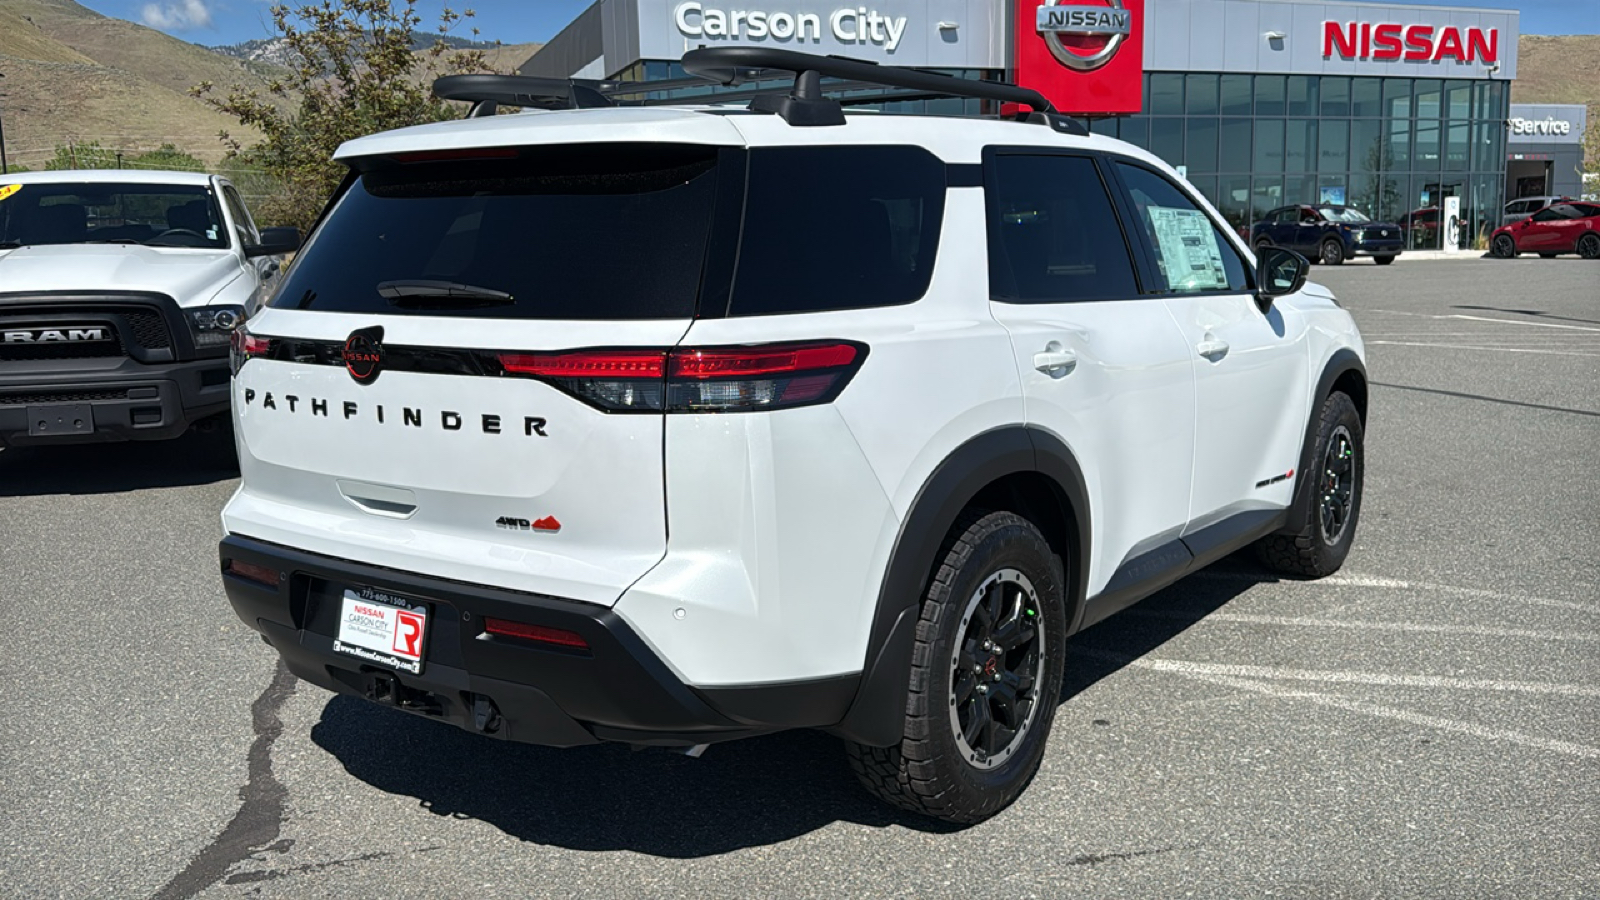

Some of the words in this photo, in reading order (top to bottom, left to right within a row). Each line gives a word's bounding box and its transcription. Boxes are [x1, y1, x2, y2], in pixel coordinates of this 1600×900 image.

[675, 2, 821, 40] Carson
[831, 8, 908, 51] City
[1048, 10, 1125, 27] NISSAN
[1323, 20, 1498, 62] NISSAN
[1513, 116, 1571, 135] Service
[4, 329, 102, 342] RAM
[341, 351, 380, 363] NISSAN
[245, 388, 549, 437] PATHFINDER
[494, 515, 530, 530] 4WD
[354, 605, 385, 619] NISSAN
[348, 613, 374, 627] CARSON
[374, 619, 389, 630] CITY
